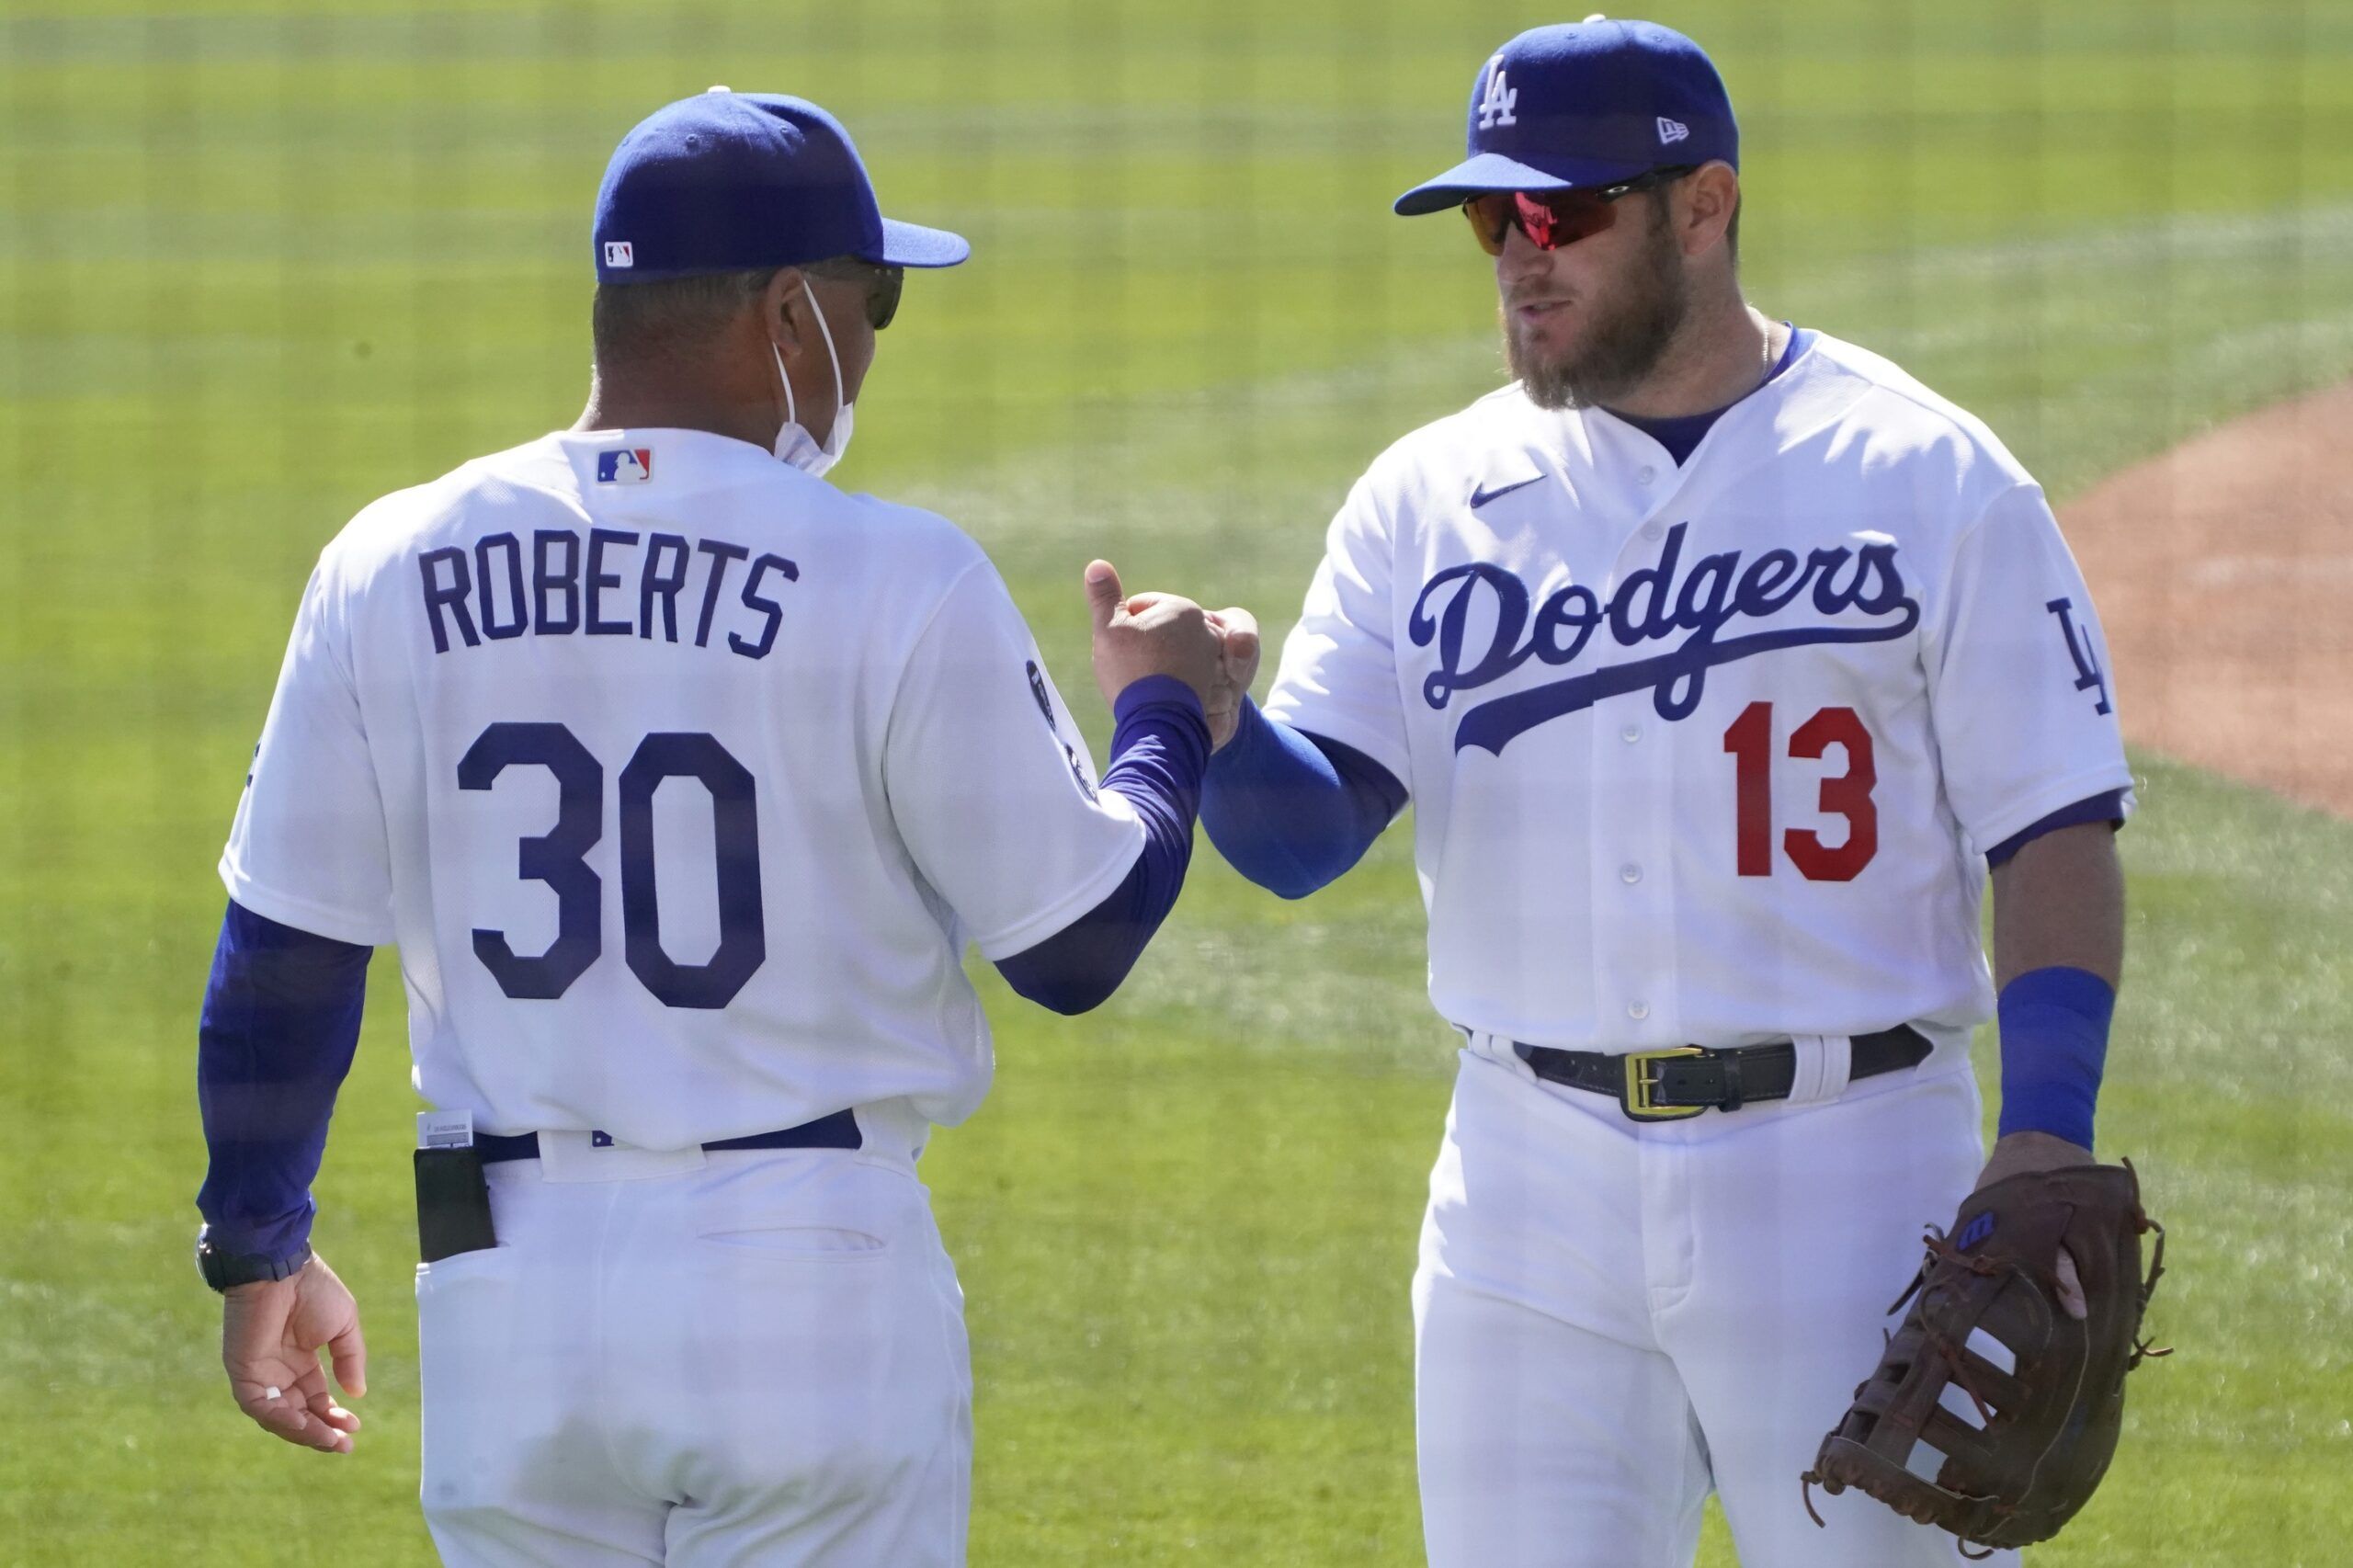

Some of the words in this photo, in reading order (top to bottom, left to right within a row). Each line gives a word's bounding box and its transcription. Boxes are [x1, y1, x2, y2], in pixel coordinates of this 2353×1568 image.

[1479, 54, 1518, 131] LA
[418, 528, 800, 660] ROBERTS
[1409, 522, 1918, 722] Dodgers
[457, 722, 766, 1009] 30
[1723, 701, 1878, 881] 13
